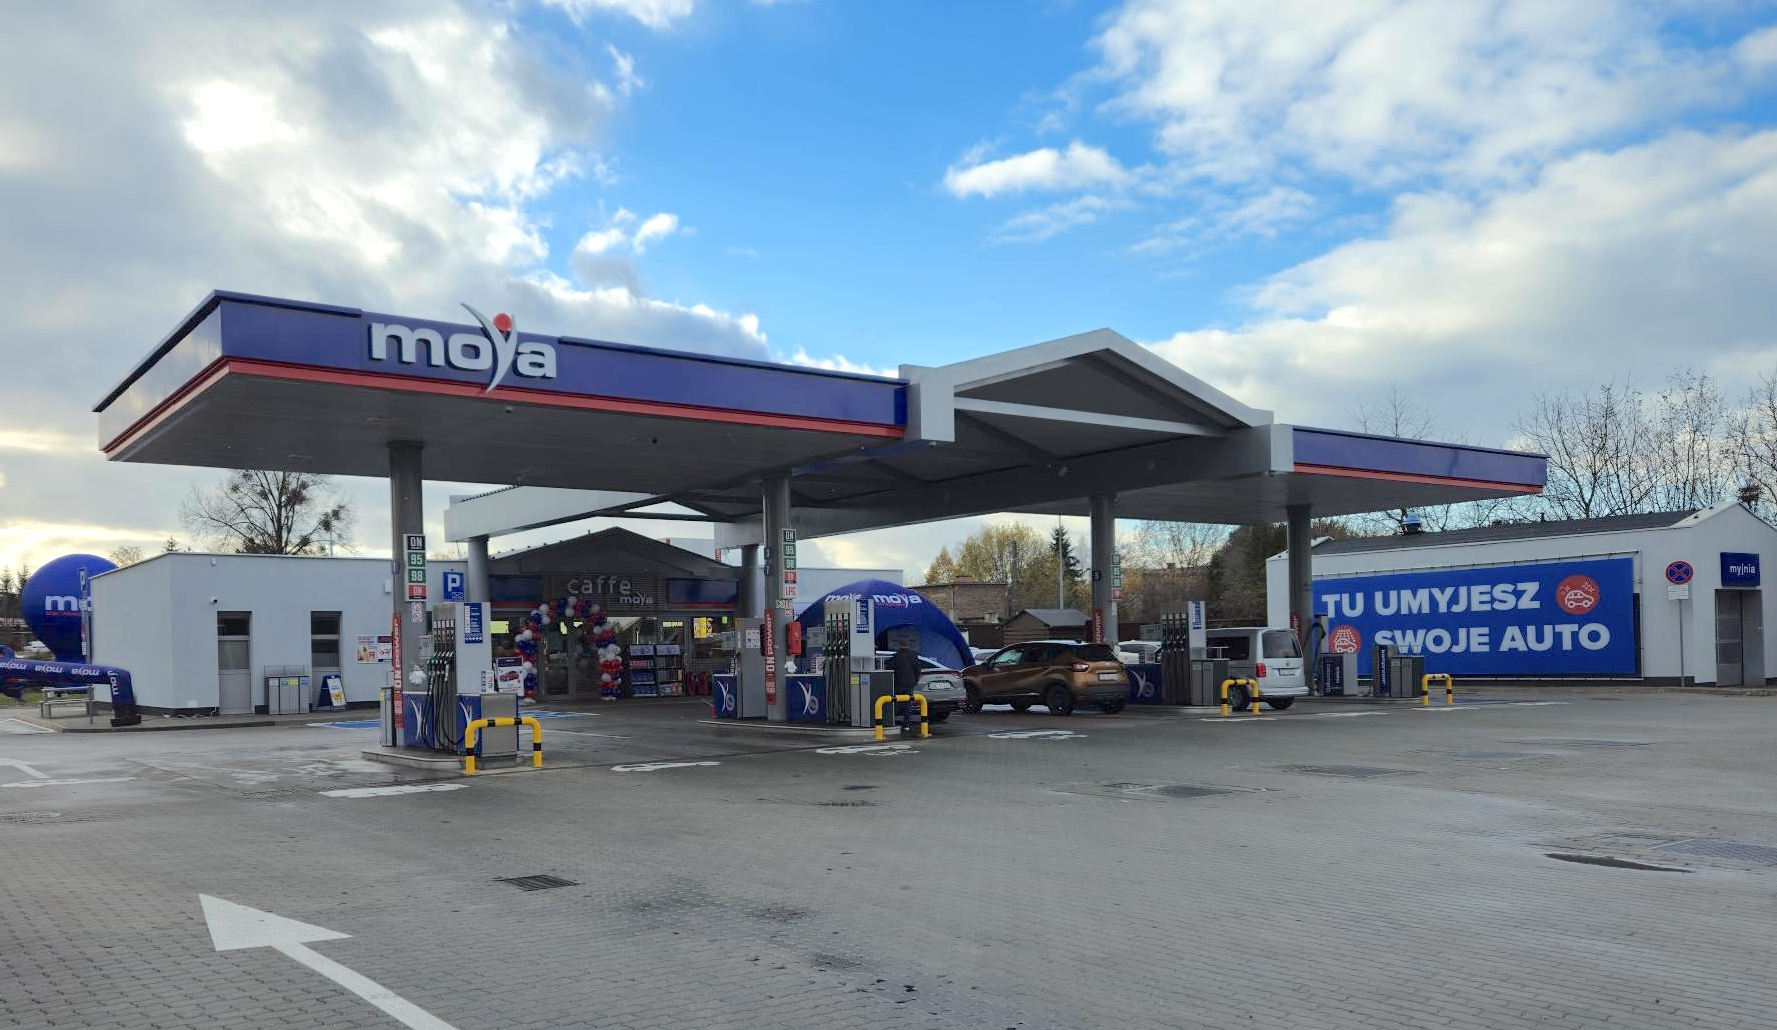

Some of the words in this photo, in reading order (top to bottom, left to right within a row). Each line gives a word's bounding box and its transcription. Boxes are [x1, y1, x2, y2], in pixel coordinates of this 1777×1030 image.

[371, 303, 556, 393] moya
[410, 536, 422, 546] ON
[785, 546, 794, 554] 95
[410, 554, 422, 565] 95
[411, 571, 423, 581] 98
[447, 573, 460, 592] P
[568, 576, 632, 594] caffe
[873, 592, 922, 608] moya
[1322, 592, 1364, 618] TU
[1375, 581, 1540, 616] UMYJESZ
[393, 618, 401, 668] power
[1374, 626, 1490, 653] SWOJE
[1498, 622, 1611, 652] AUTO
[393, 670, 402, 688] ON
